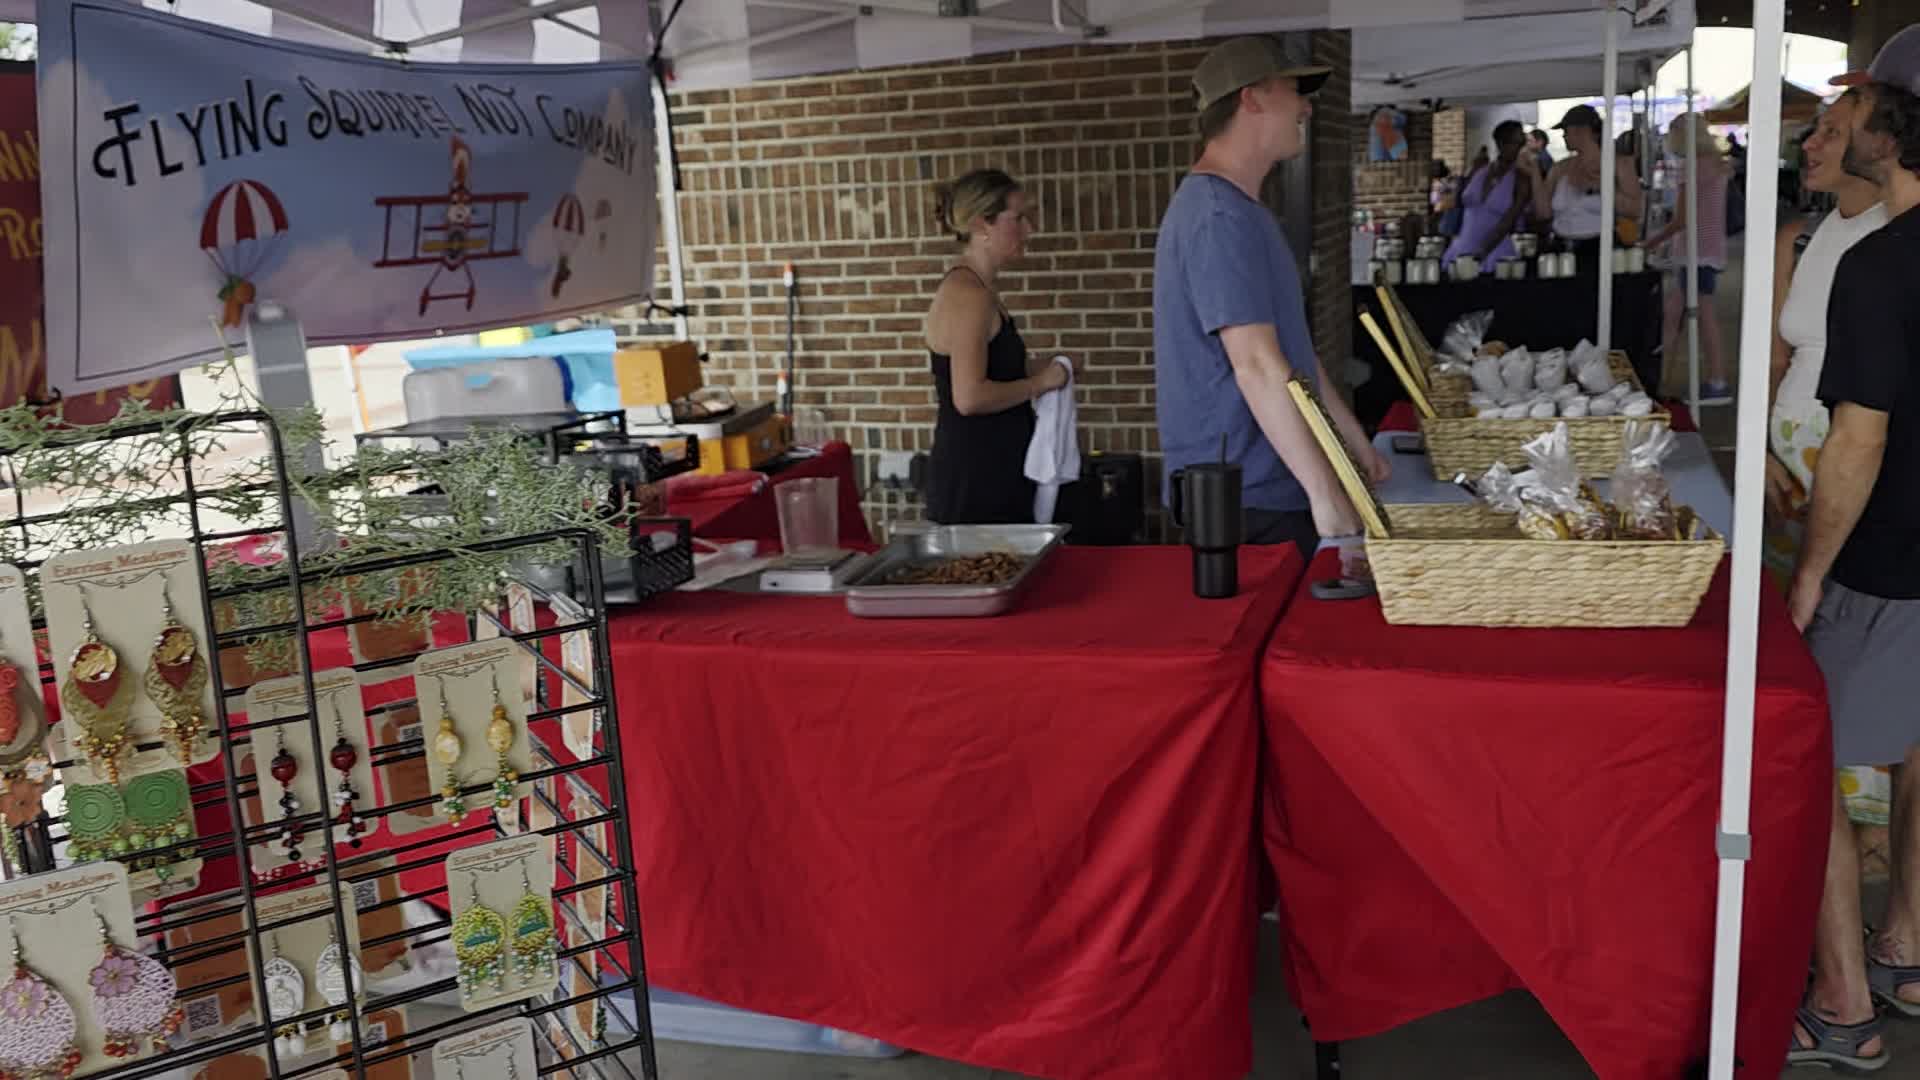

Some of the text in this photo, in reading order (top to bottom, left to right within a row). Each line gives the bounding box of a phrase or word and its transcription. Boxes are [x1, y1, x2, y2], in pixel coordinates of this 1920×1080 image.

[92, 79, 288, 186] FLYING
[297, 75, 466, 139] SQUIRREL
[453, 84, 534, 137] NUT
